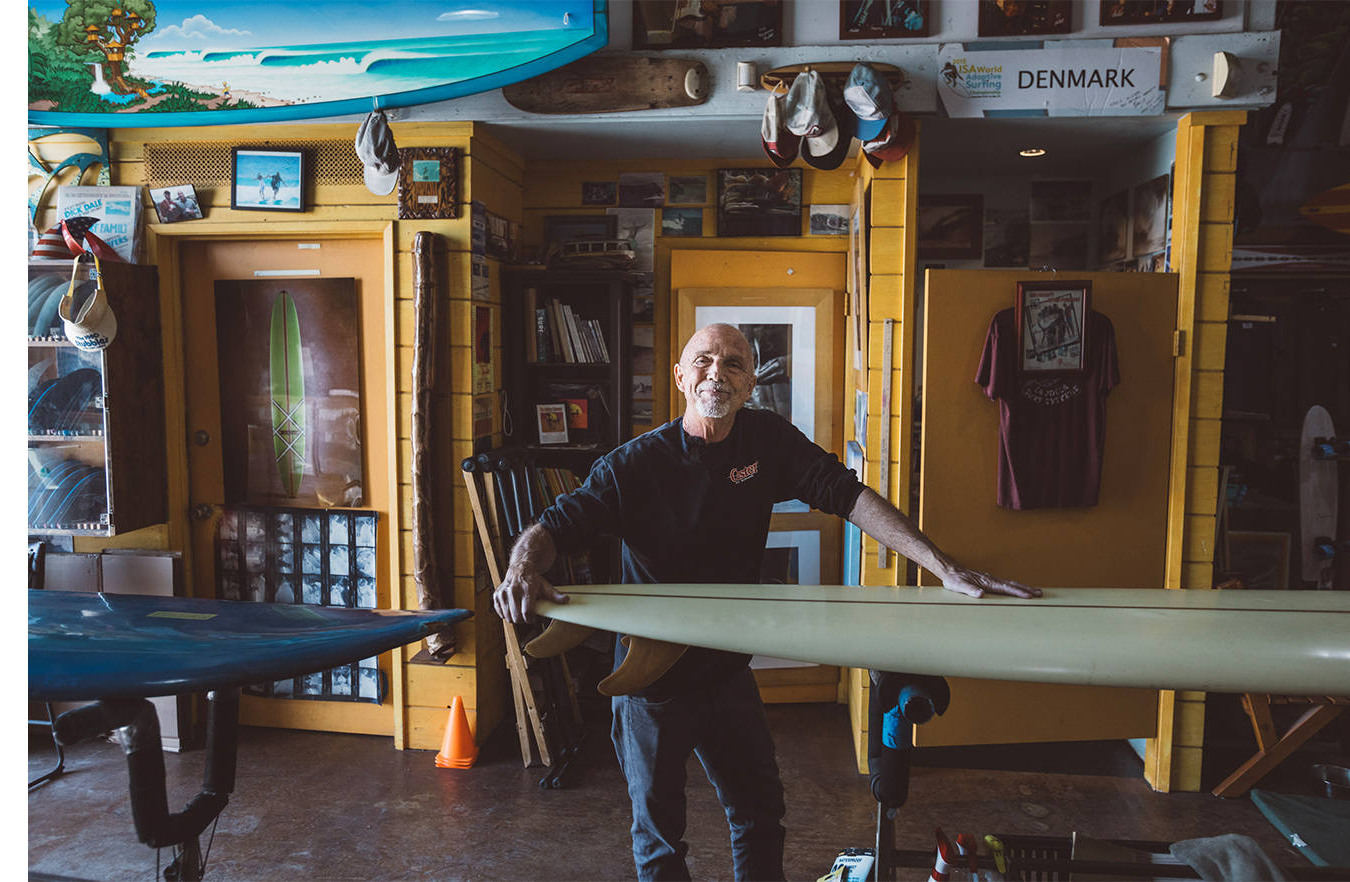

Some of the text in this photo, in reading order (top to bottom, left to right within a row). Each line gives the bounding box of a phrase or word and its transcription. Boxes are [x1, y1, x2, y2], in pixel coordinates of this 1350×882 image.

[965, 73, 1002, 81] Adaptive
[1017, 68, 1135, 89] DENMARK
[966, 80, 1002, 91] Surfing
[64, 206, 83, 218] DICK
[84, 199, 103, 212] DALE
[100, 223, 128, 234] FAMILY
